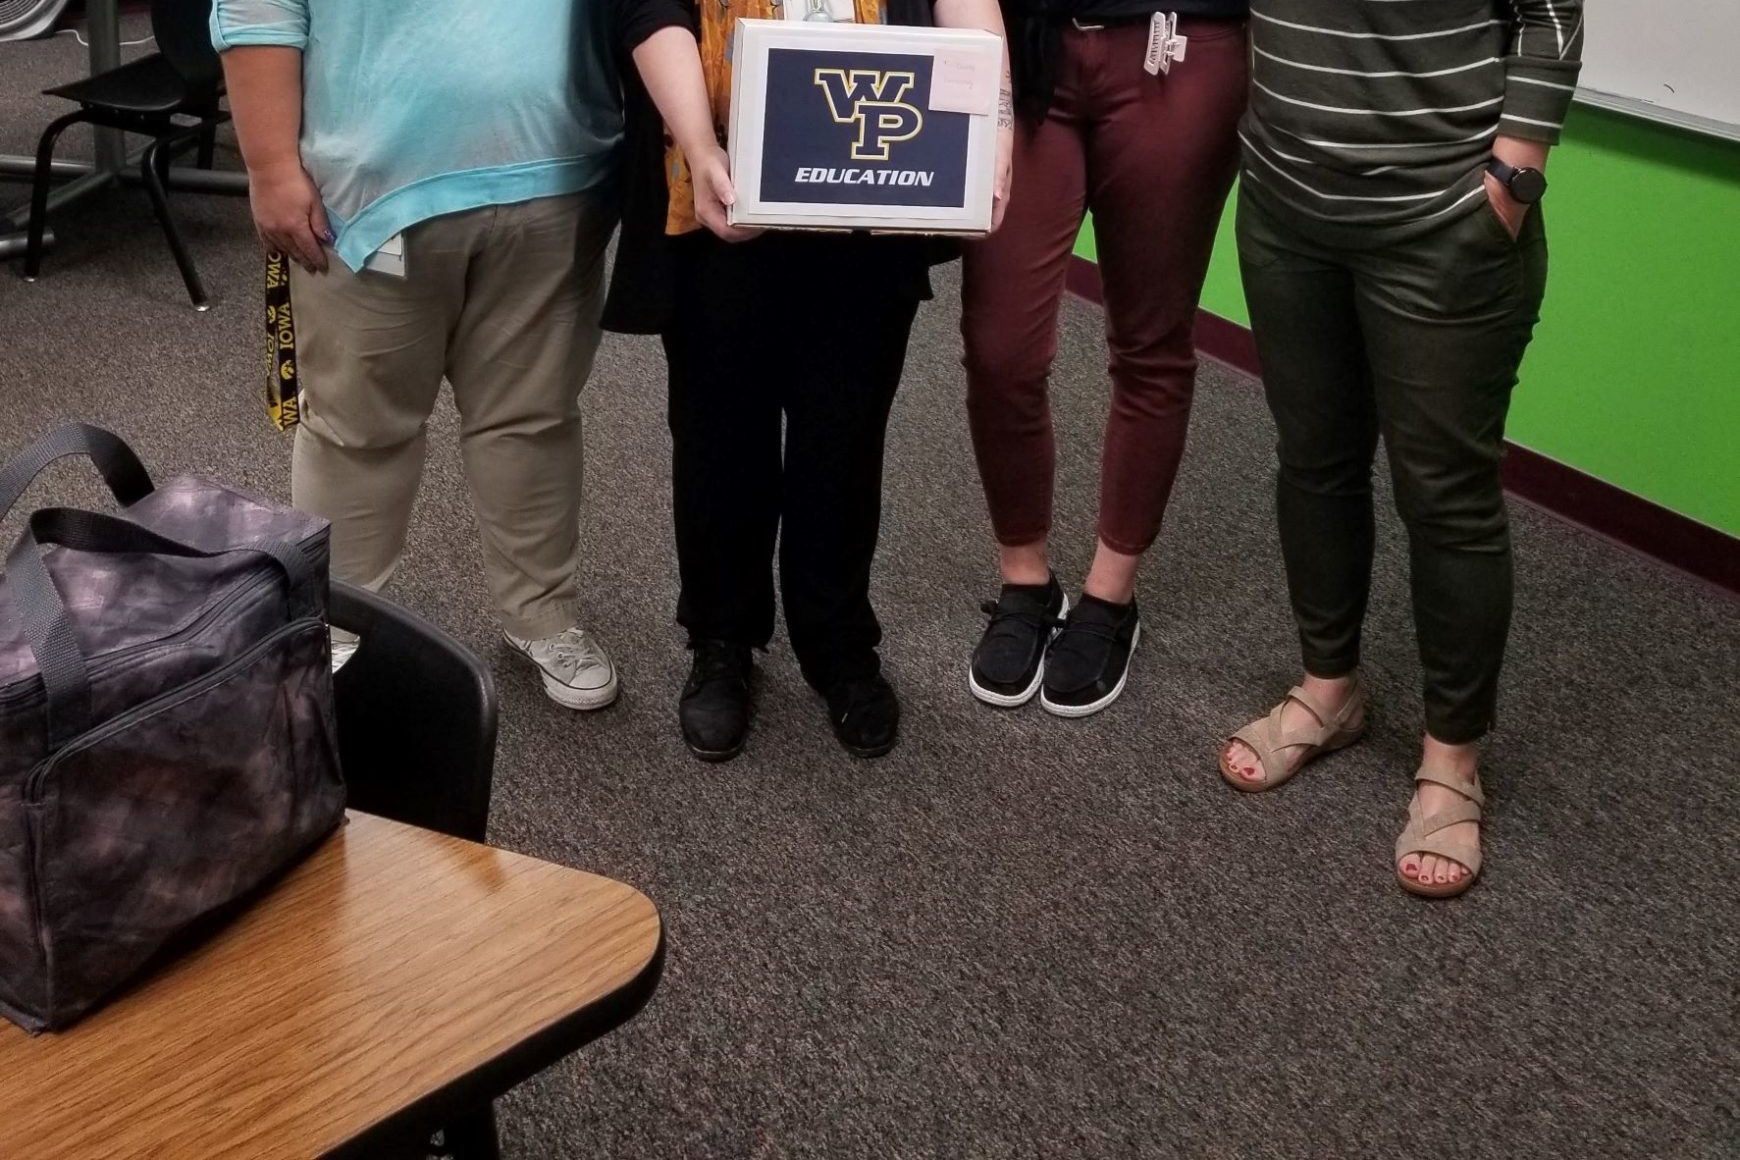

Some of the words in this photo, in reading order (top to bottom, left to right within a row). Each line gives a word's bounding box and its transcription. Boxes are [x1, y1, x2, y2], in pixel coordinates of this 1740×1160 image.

[794, 167, 935, 187] EDUCATION
[266, 251, 282, 289] OWA
[278, 302, 294, 350] IOWA
[282, 396, 299, 425] WA
